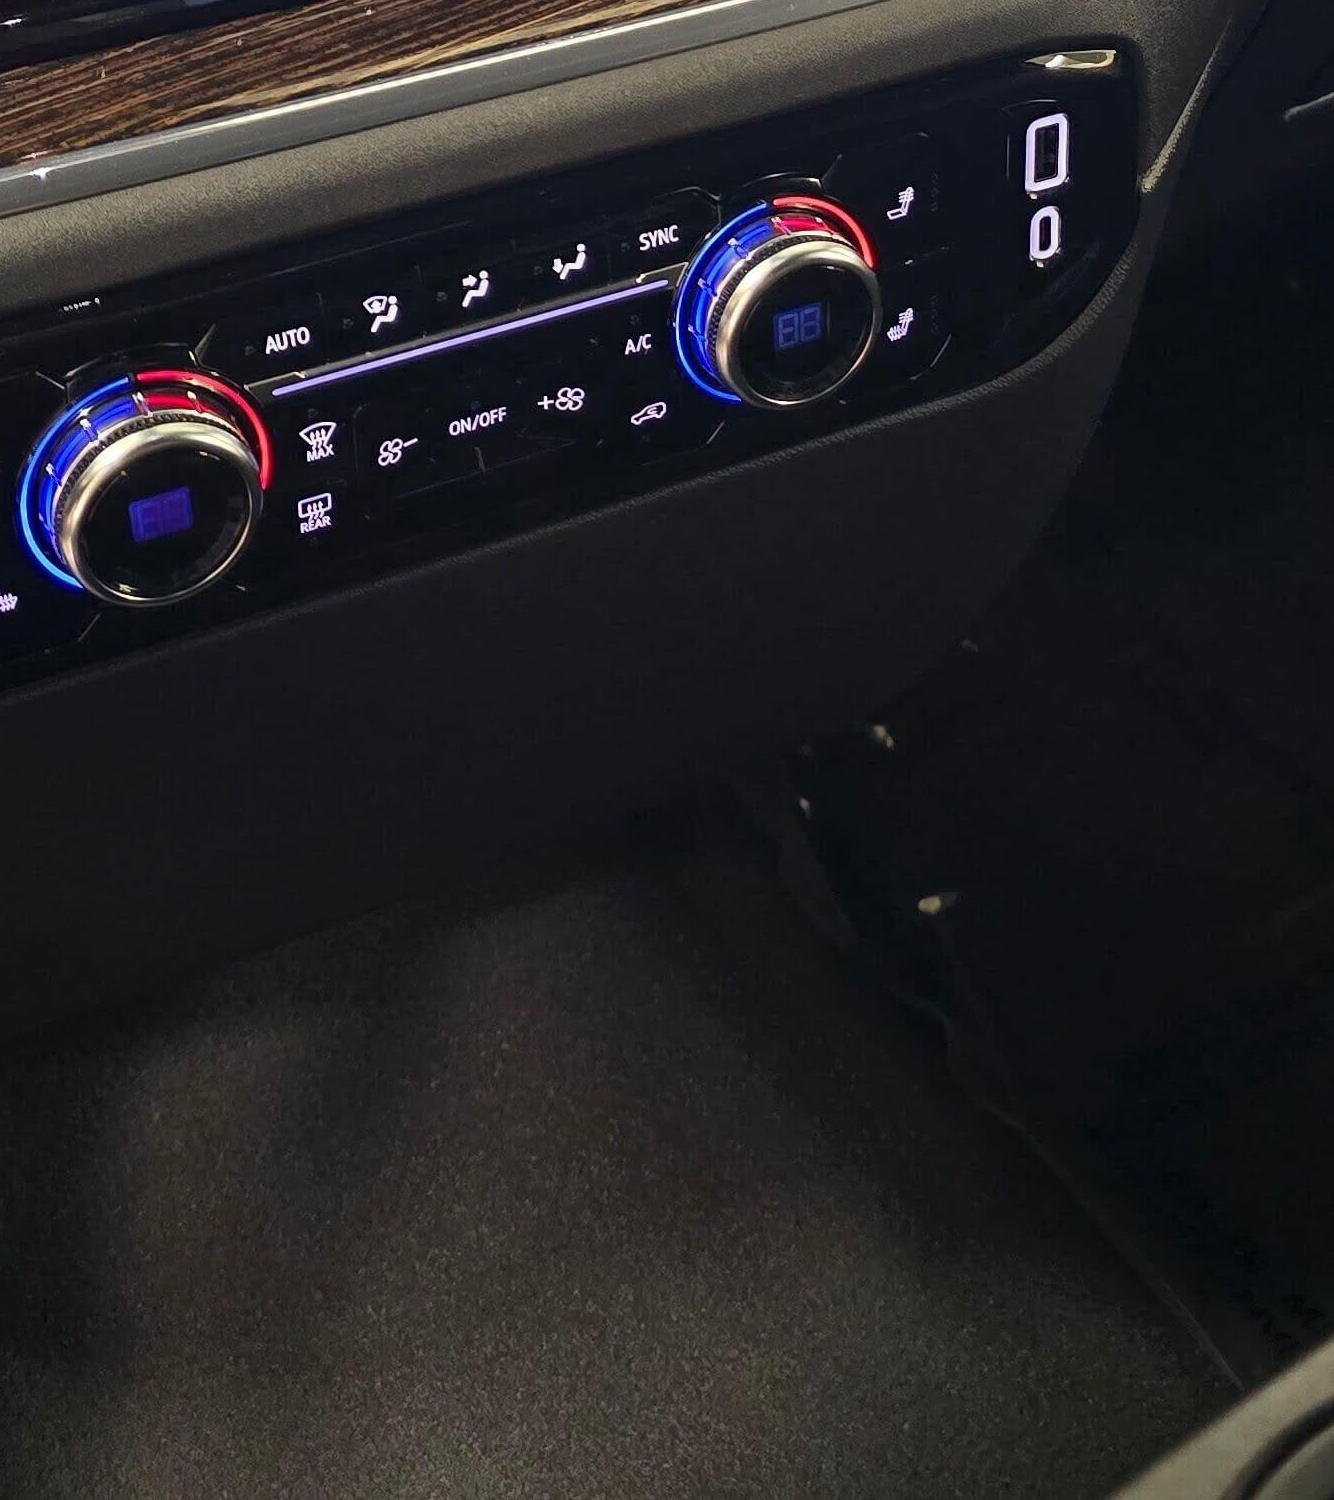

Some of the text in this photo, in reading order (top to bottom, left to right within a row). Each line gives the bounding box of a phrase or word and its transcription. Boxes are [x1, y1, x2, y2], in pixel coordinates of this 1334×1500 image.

[639, 225, 679, 250] SYNC
[266, 327, 310, 354] AUTO
[625, 334, 651, 355] A/C
[449, 407, 506, 435] ON/OFF
[307, 443, 335, 462] MAX
[299, 514, 332, 534] REAR
